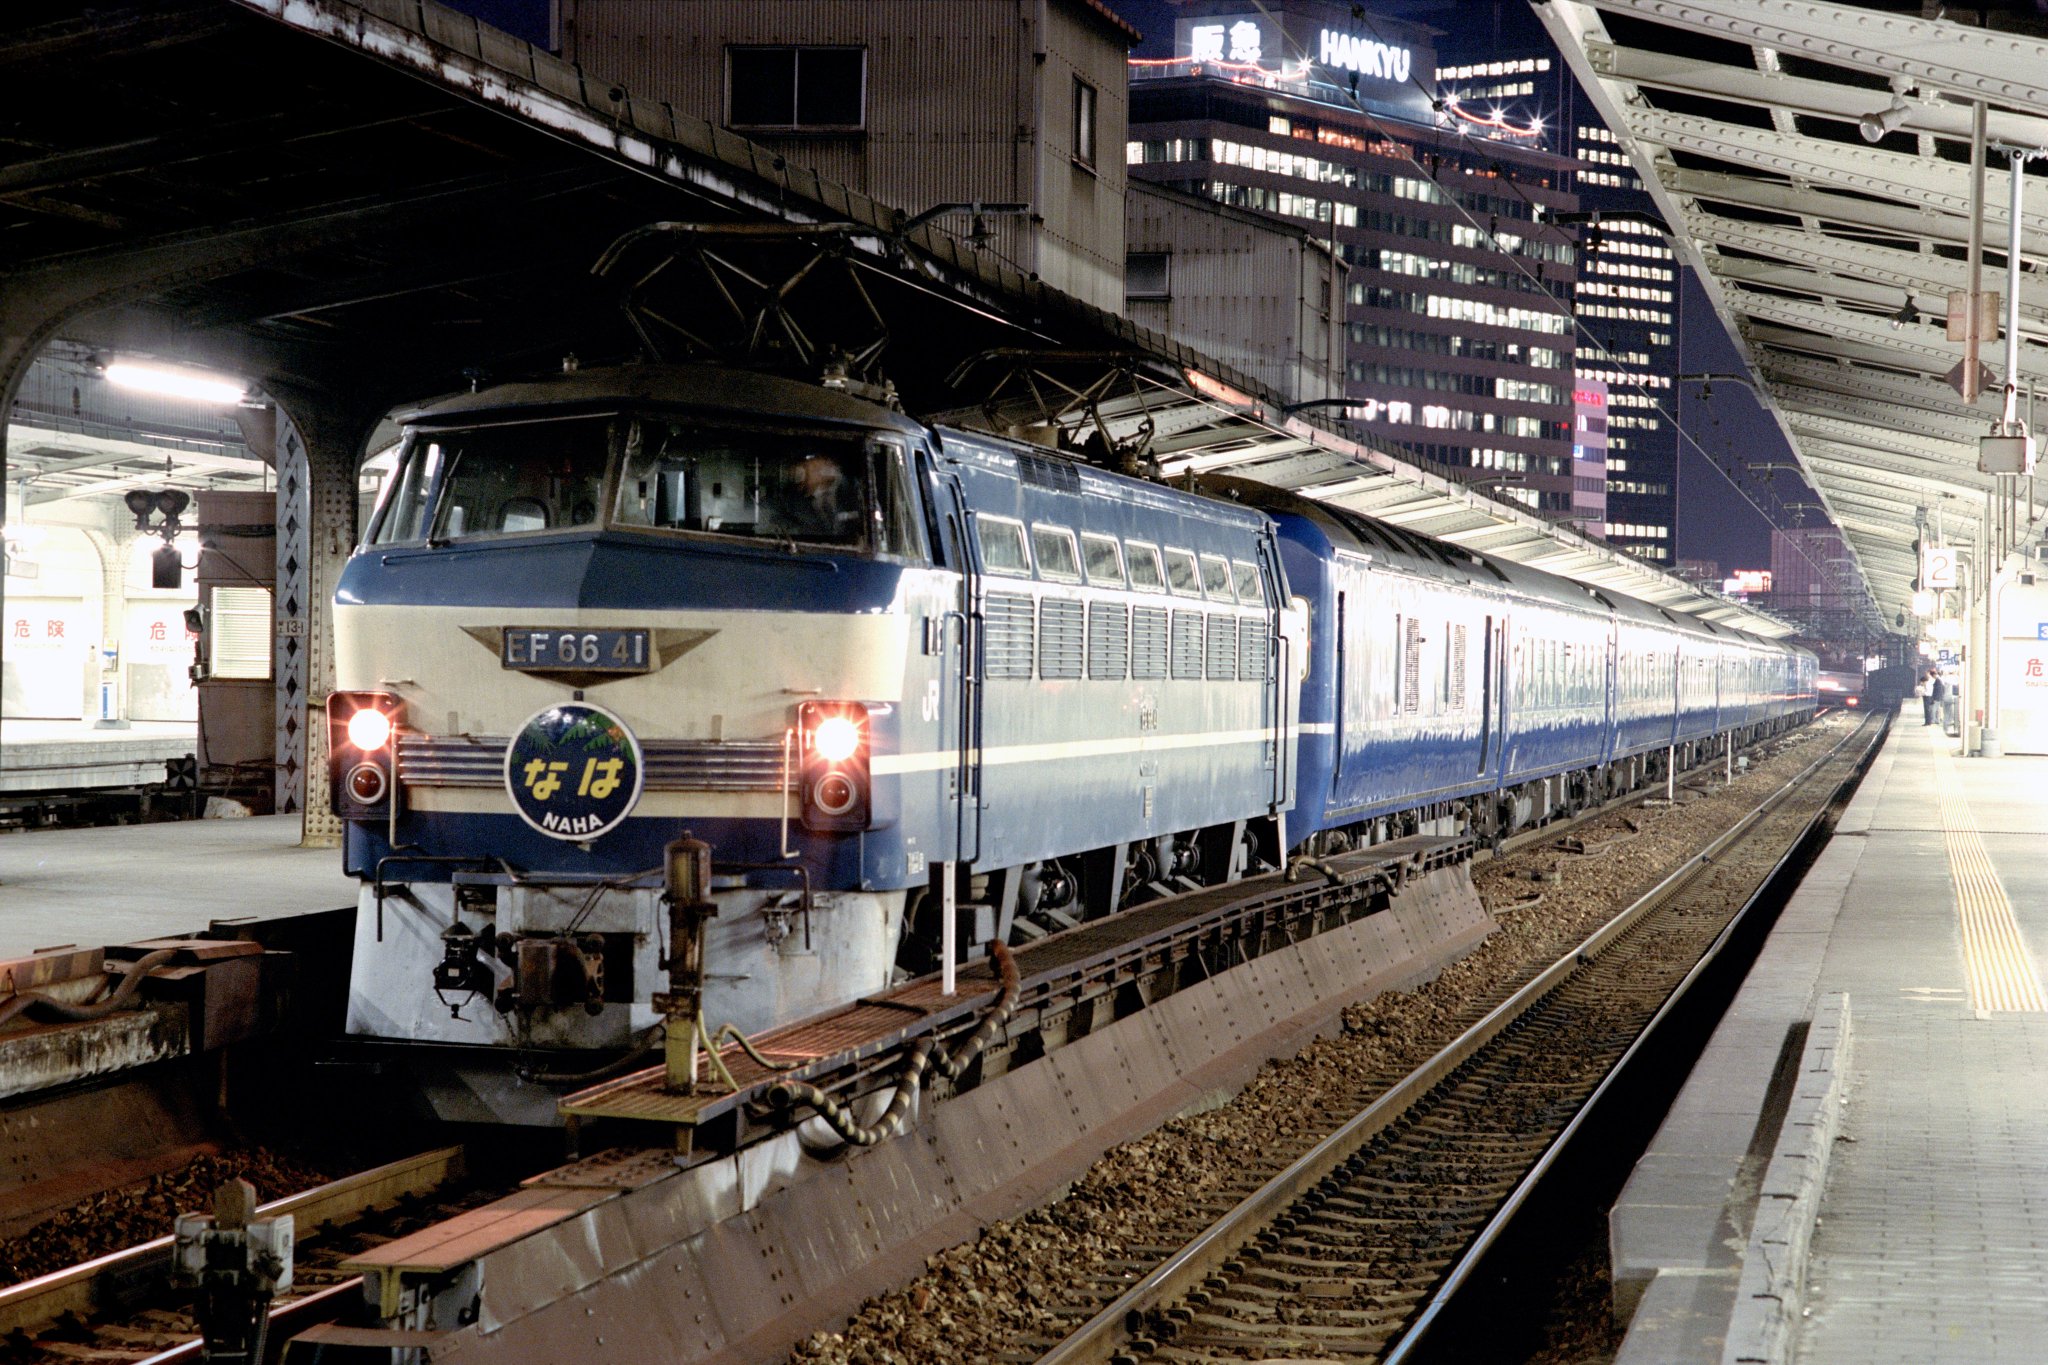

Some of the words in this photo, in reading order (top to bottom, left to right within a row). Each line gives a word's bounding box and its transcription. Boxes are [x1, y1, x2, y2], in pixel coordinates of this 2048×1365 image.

[1192, 20, 1261, 63] 阪急
[1320, 28, 1411, 83] HANKYU
[1932, 556, 1949, 580] 2
[14, 619, 65, 638] 危険
[508, 633, 549, 663] EF
[558, 634, 599, 664] 66
[611, 635, 643, 664] 41
[922, 679, 940, 722] JR
[523, 757, 625, 801] なは
[542, 811, 604, 834] NAHA
